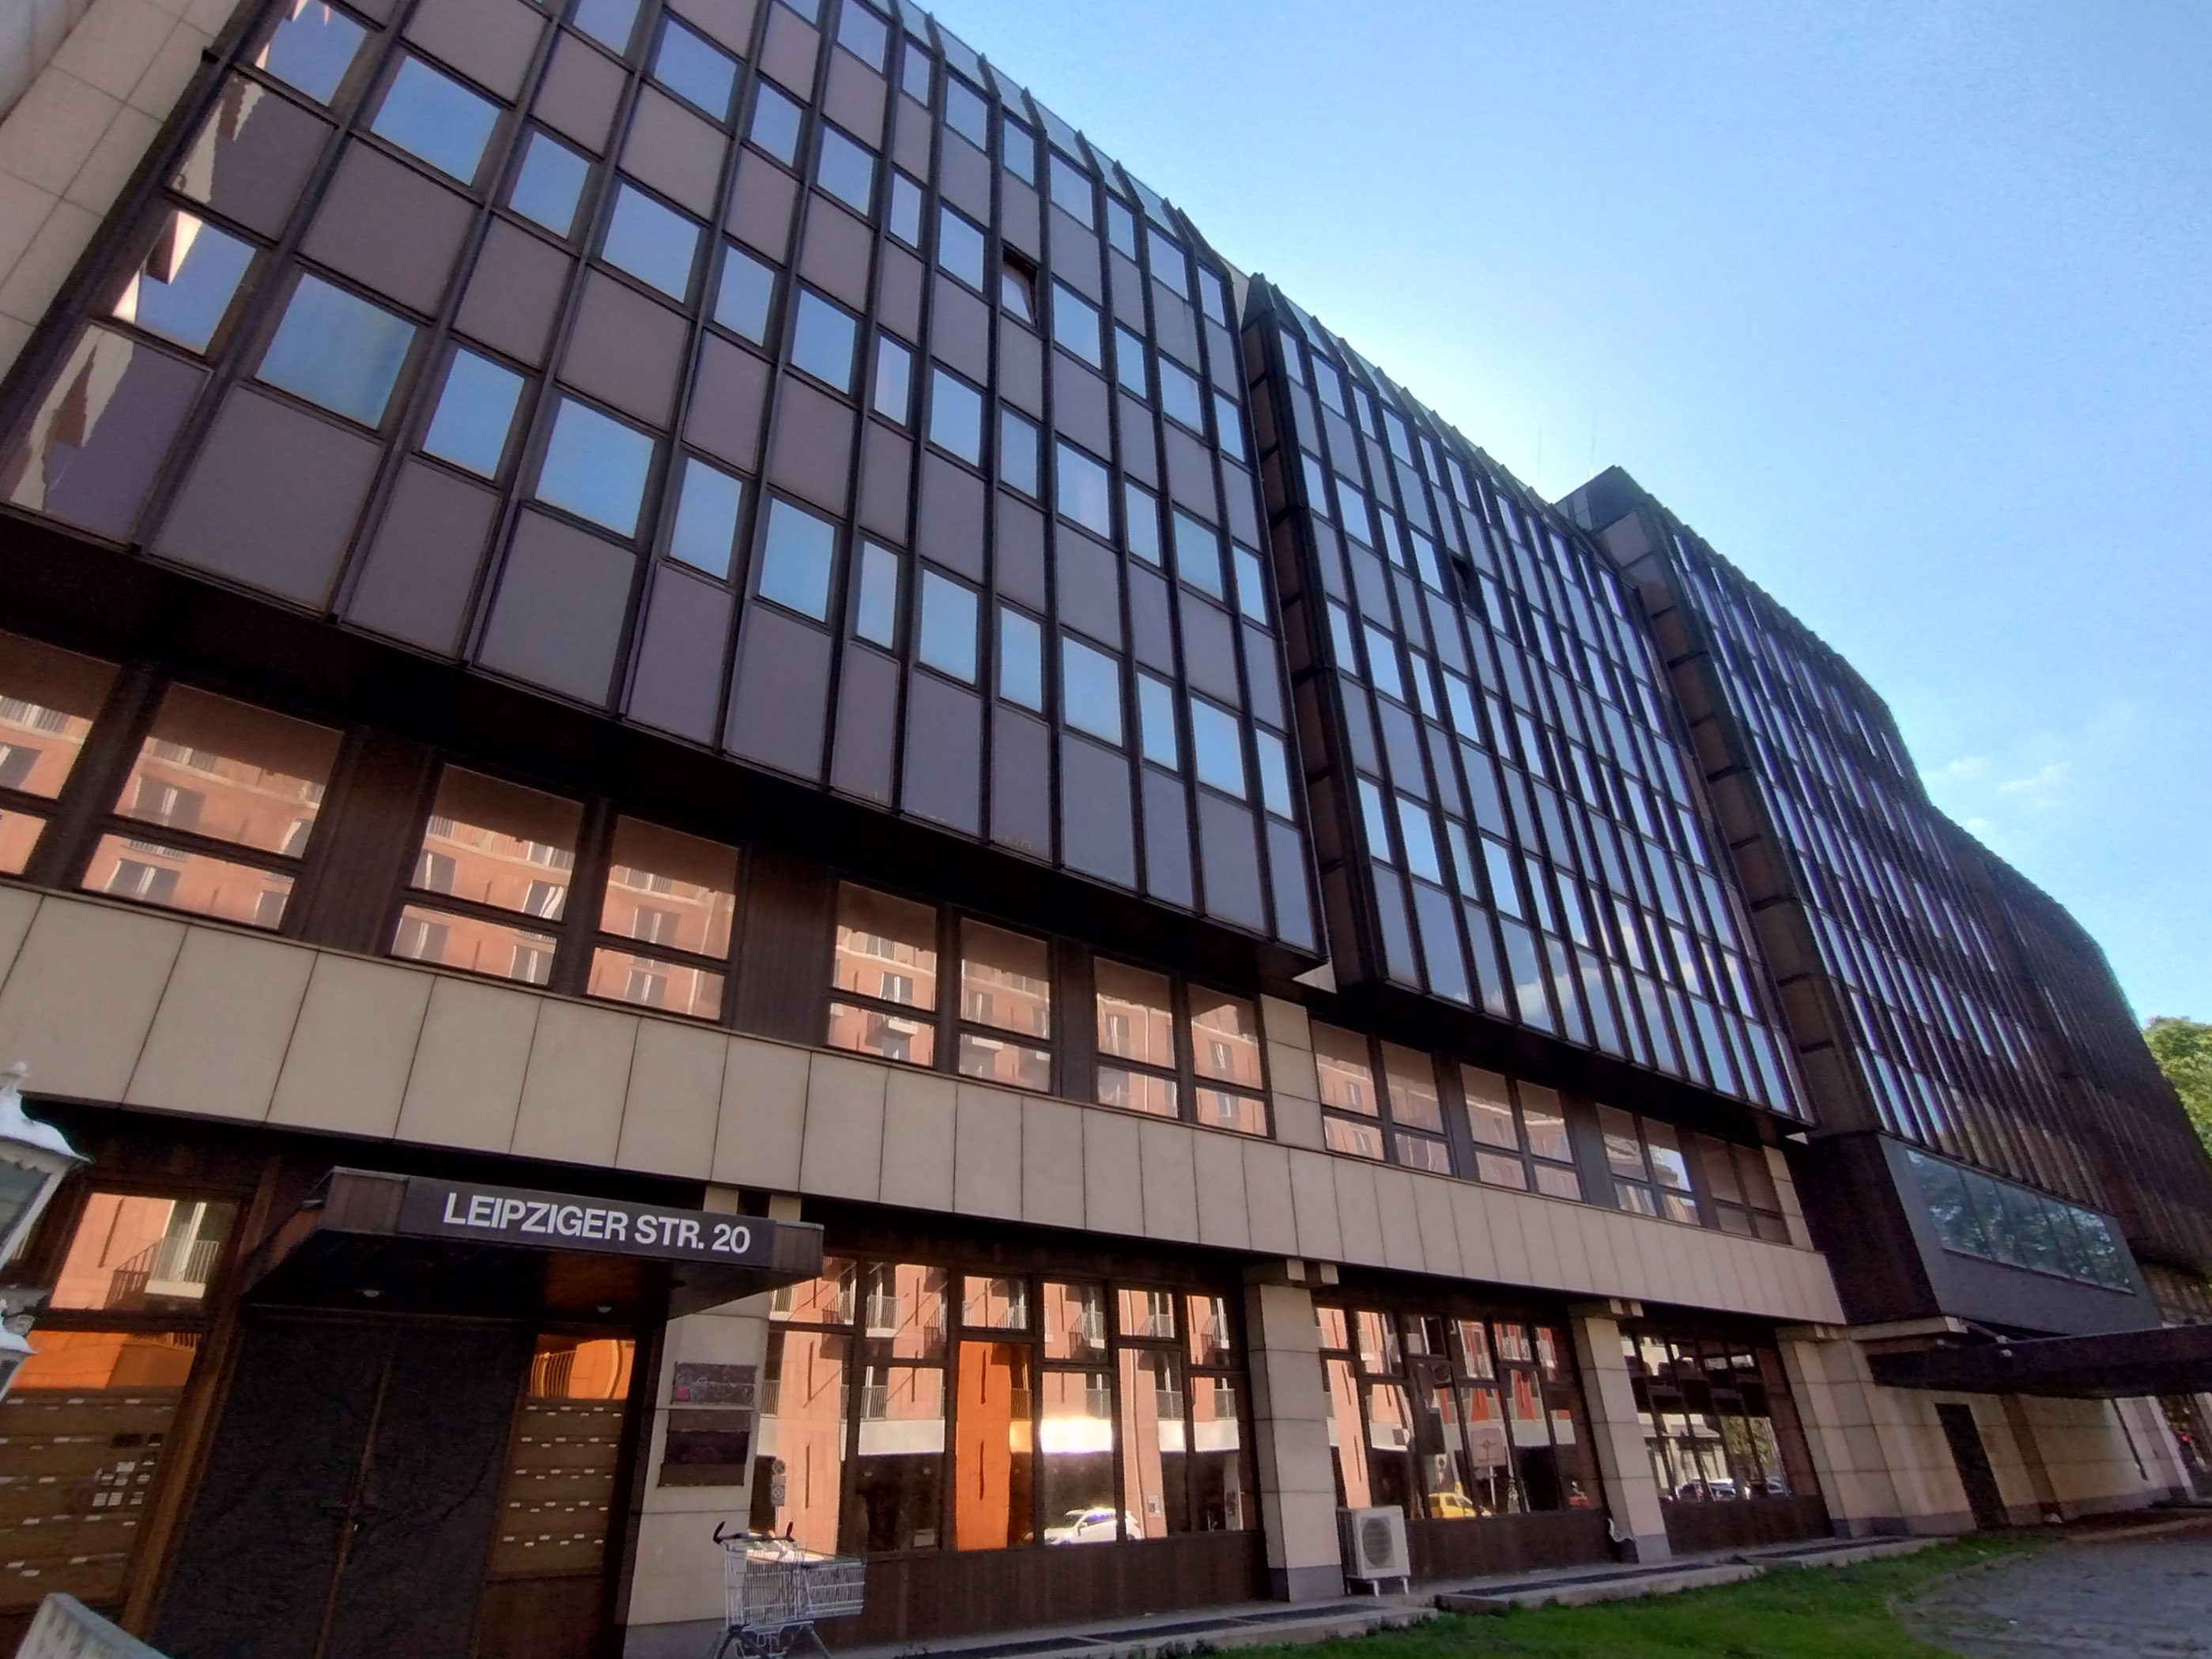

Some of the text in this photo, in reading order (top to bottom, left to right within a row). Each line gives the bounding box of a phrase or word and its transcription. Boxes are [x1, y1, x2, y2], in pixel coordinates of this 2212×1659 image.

[444, 1192, 750, 1254] LEIPZIGER STR. 20
